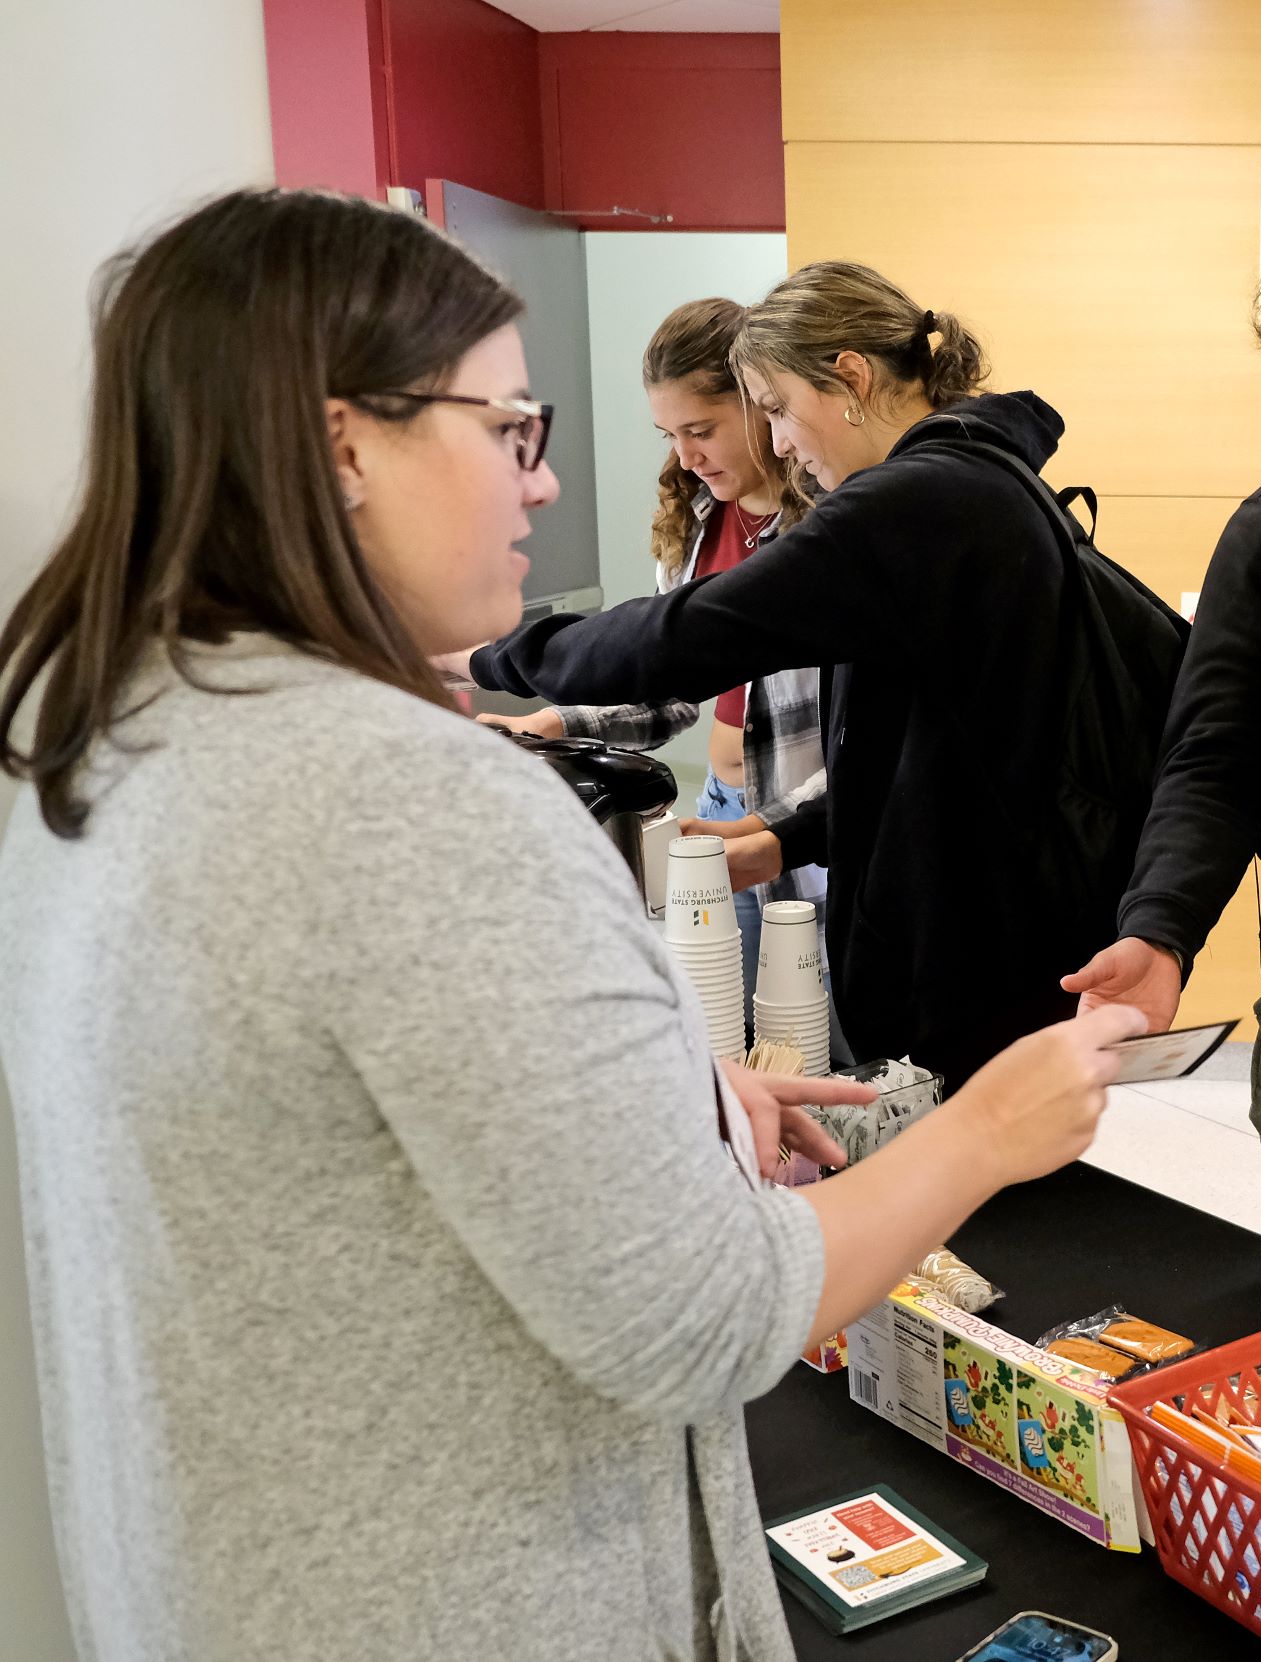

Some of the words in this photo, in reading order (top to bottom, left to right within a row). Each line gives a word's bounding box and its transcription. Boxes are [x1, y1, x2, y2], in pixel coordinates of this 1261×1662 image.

[671, 885, 729, 898] UNIVERSITY
[671, 897, 689, 906] STATE
[691, 895, 729, 906] FITCHBURG
[913, 1296, 990, 1337] PUMPKINS
[919, 1319, 935, 1333] Facts
[986, 1332, 1065, 1377] BROWNIE
